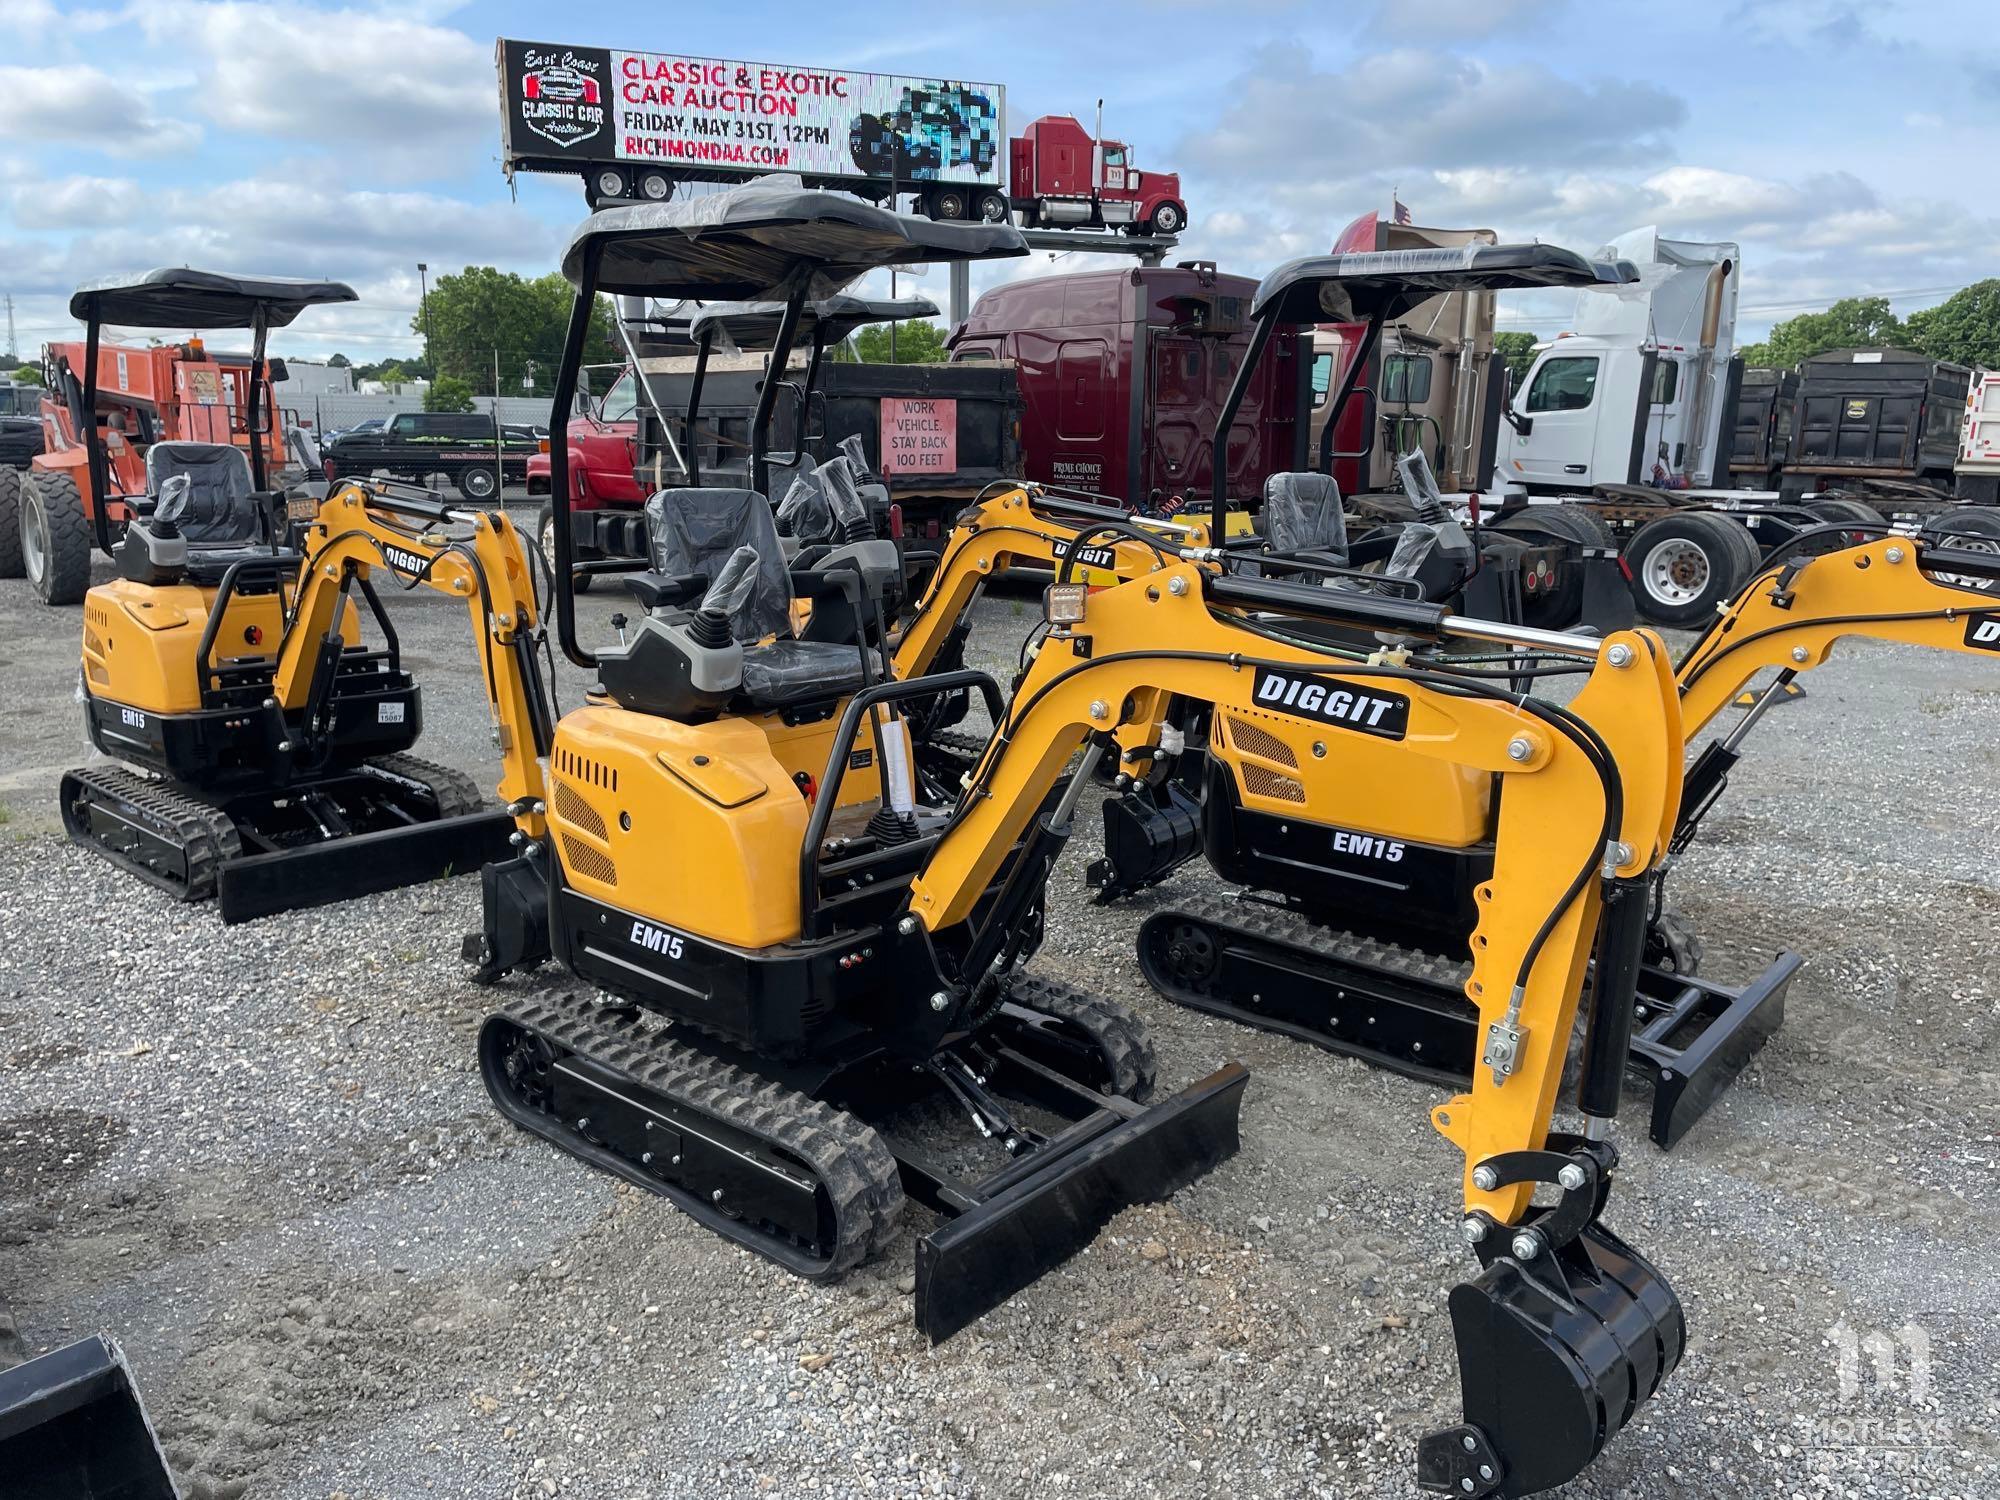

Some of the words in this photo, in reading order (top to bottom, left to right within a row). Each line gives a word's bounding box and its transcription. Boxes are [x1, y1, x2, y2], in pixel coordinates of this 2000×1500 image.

[622, 57, 726, 87] CLASSIC
[735, 68, 752, 89] &
[760, 71, 848, 98] EXOTIC
[623, 82, 675, 106] CAR
[684, 88, 797, 117] AUCTION
[522, 101, 574, 120] CLASSIC
[578, 105, 604, 125] CAR
[624, 111, 689, 136] FRIDAY,
[693, 117, 730, 137] MAY
[735, 121, 778, 144] 31ST,
[783, 124, 830, 145] 12PM
[625, 137, 789, 166] RICHMONDAA.COM
[903, 401, 936, 414] WORK
[896, 419, 943, 432] VEHICLE.
[891, 436, 918, 449] STAY
[921, 436, 948, 449] BACK
[896, 454, 916, 466] 100
[920, 453, 944, 466] FEET
[1053, 462, 1075, 474] PRIME
[1075, 462, 1102, 474] CHOICE
[1054, 543, 1112, 565] DGIT
[1257, 674, 1394, 727] DIGGIT
[121, 708, 145, 729] EM15
[1333, 831, 1406, 862] EM15
[630, 921, 684, 960] EM15
